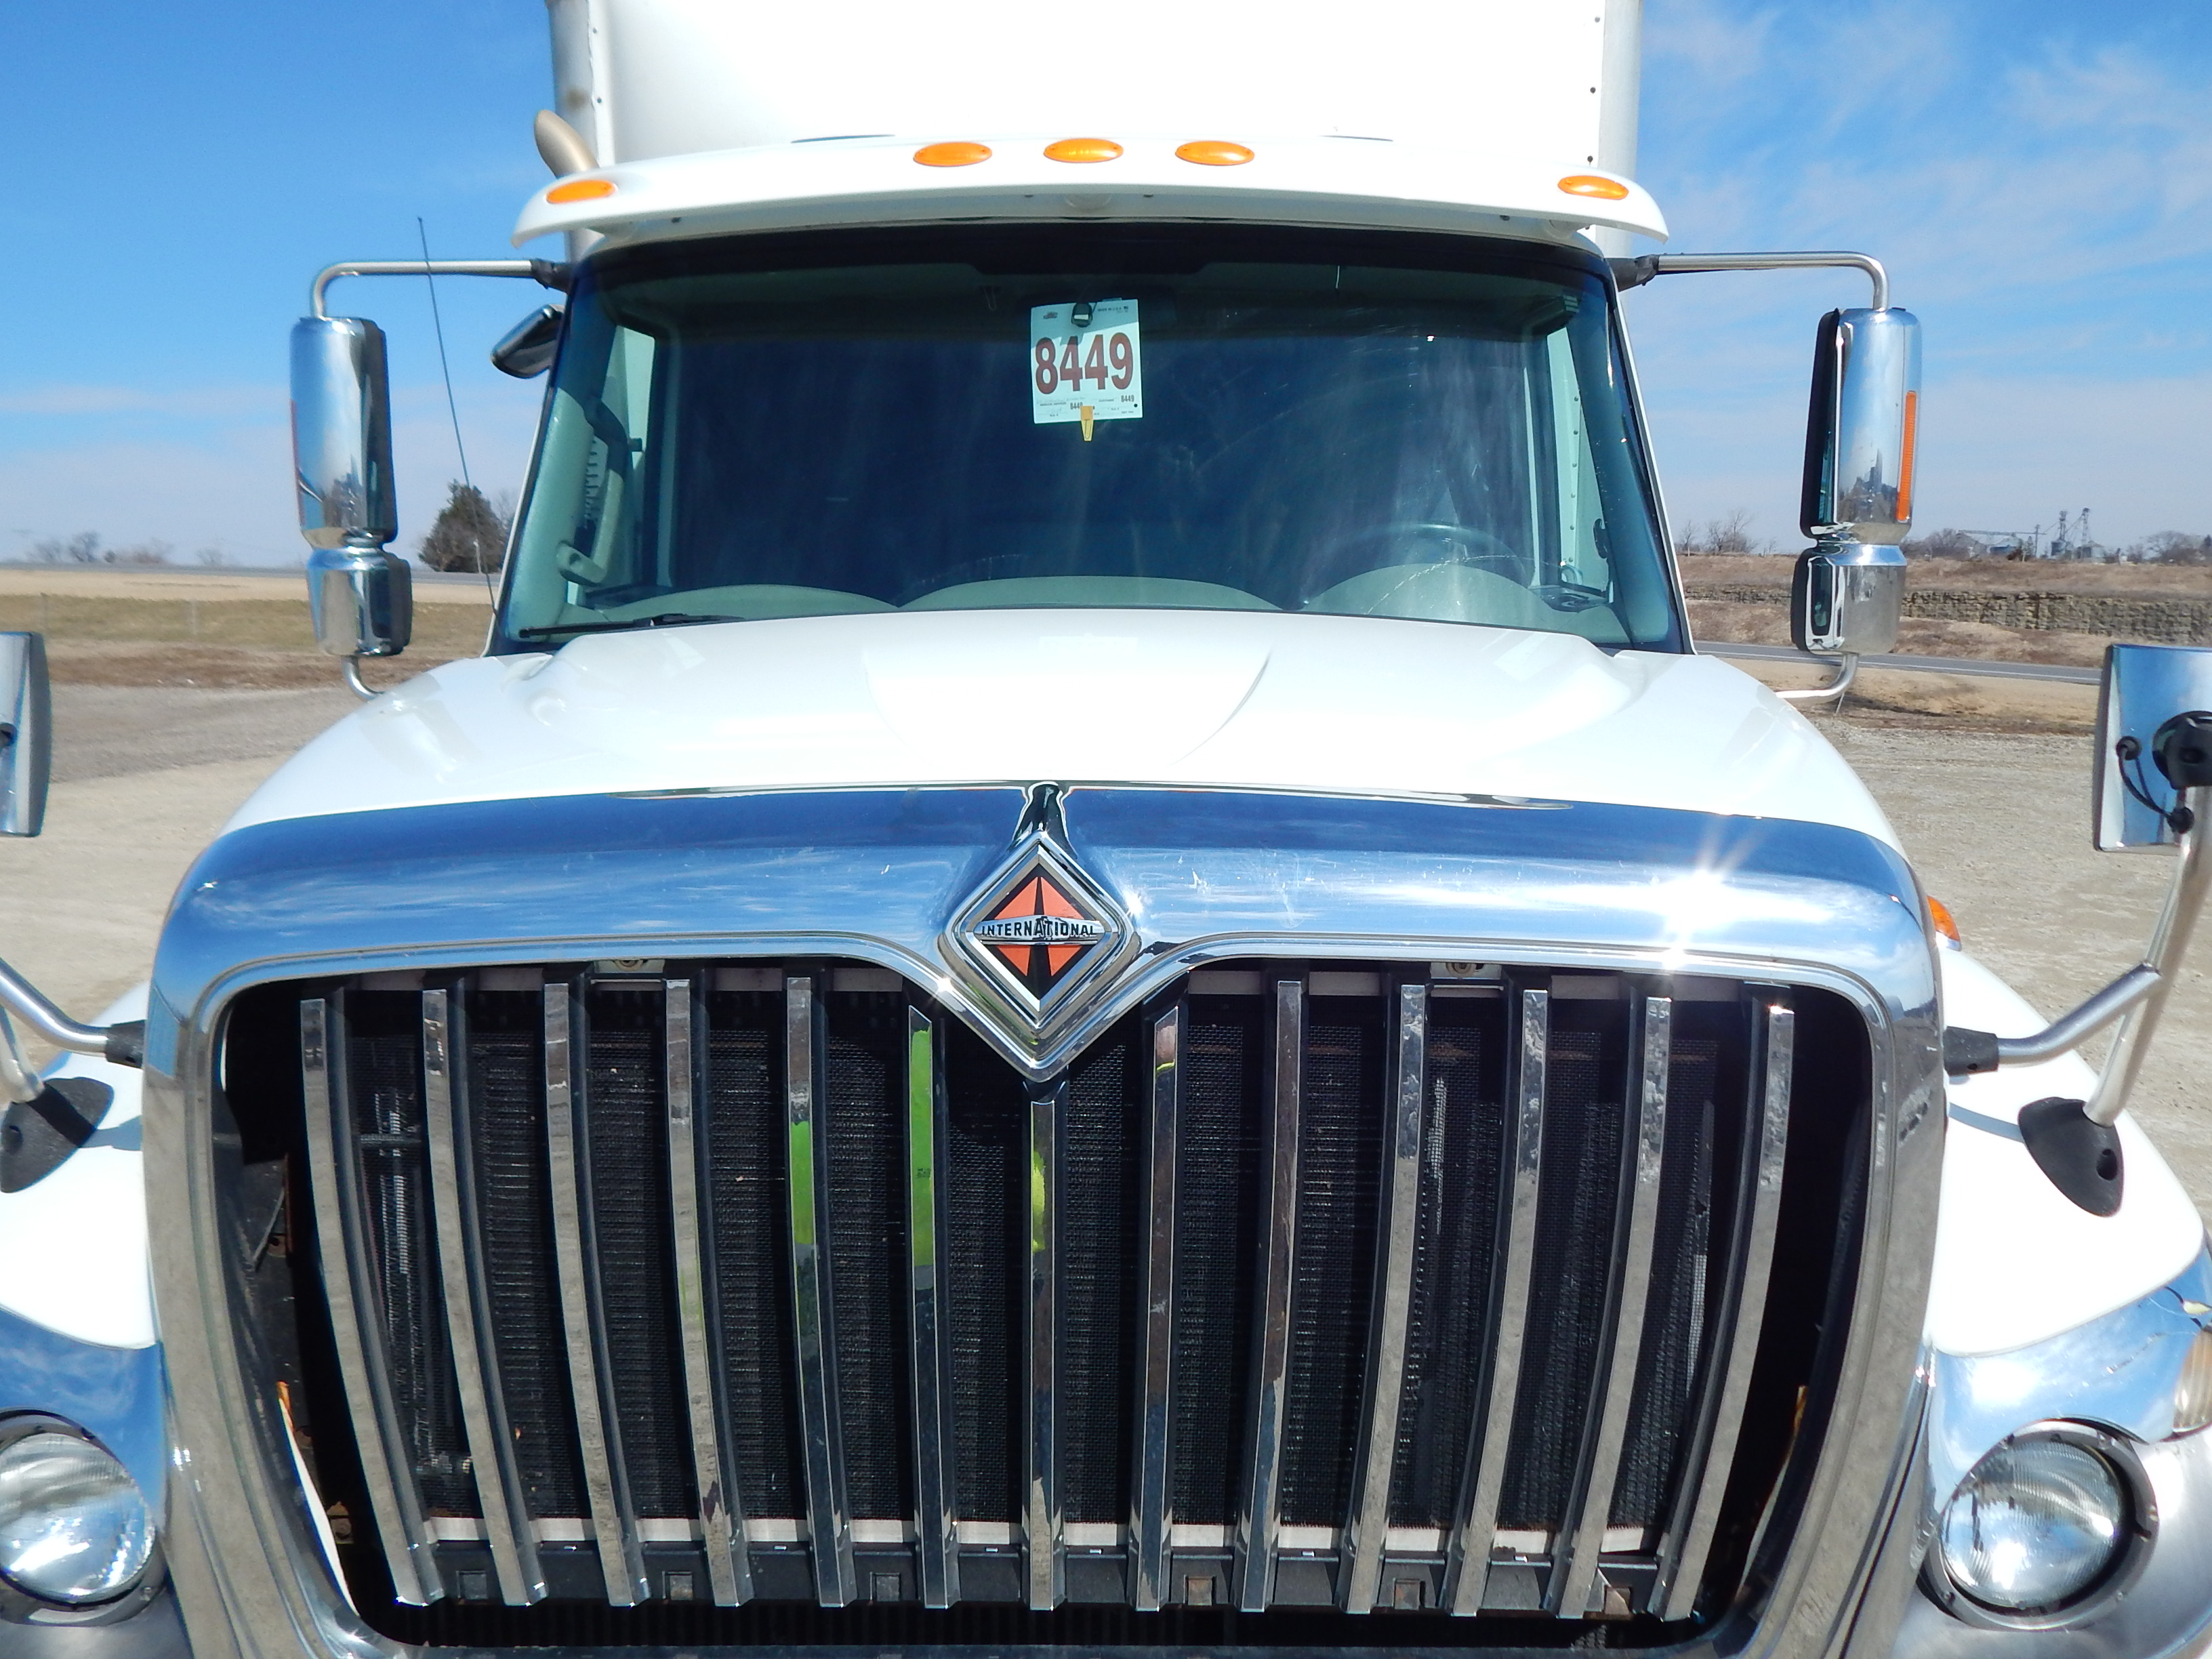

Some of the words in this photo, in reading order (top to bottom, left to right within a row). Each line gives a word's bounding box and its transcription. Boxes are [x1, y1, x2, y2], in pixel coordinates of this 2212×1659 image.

[1036, 332, 1133, 394] 8449
[1121, 394, 1134, 403] 8449
[981, 920, 1095, 937] INTERNATIONAL
